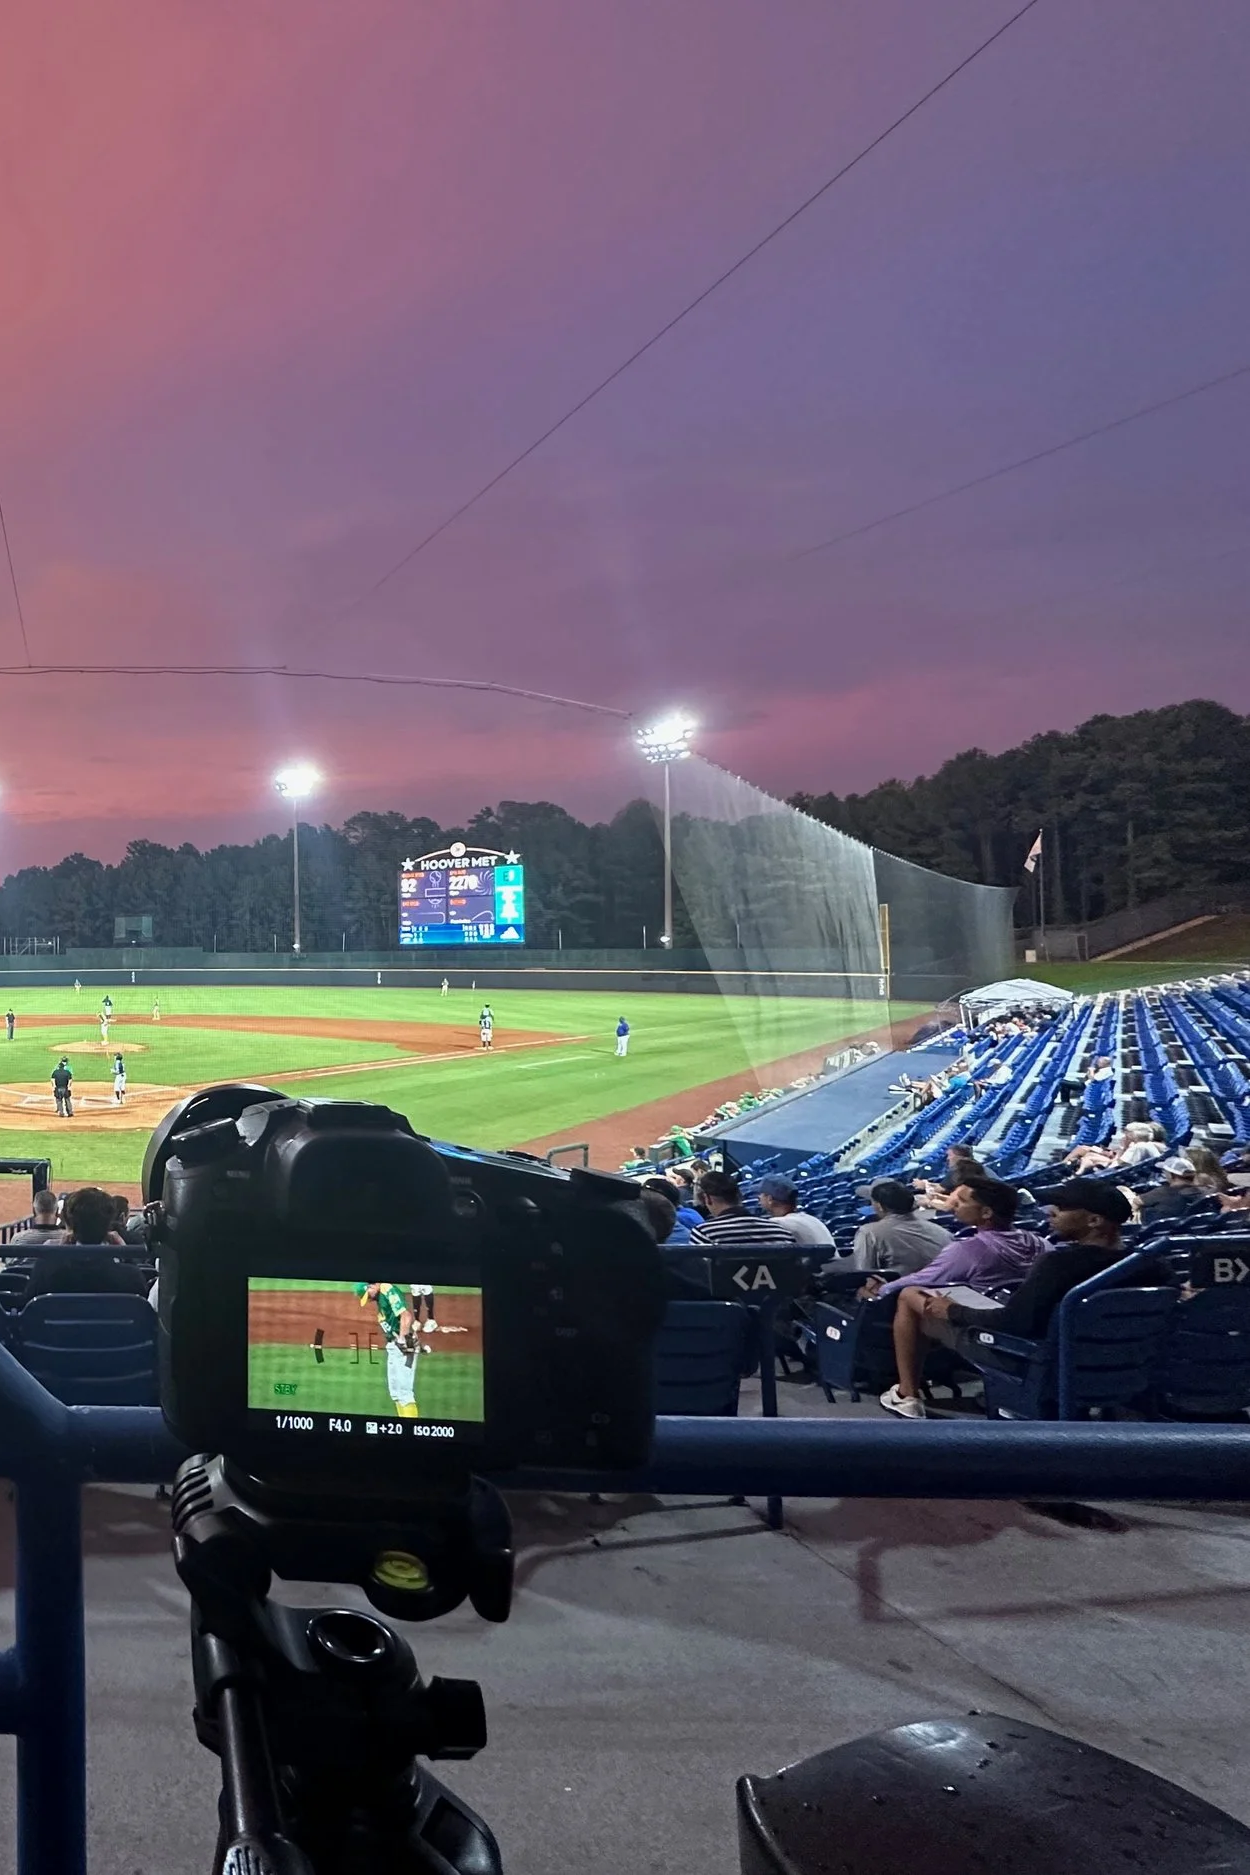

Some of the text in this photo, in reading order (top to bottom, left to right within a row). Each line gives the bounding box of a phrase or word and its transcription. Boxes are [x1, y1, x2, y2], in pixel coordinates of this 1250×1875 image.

[420, 855, 498, 871] HOOVER MET
[751, 1265, 777, 1290] A
[1214, 1258, 1234, 1282] B
[276, 1415, 313, 1430] 1/1000
[329, 1418, 351, 1432] F4.0
[379, 1422, 403, 1435] +2.0
